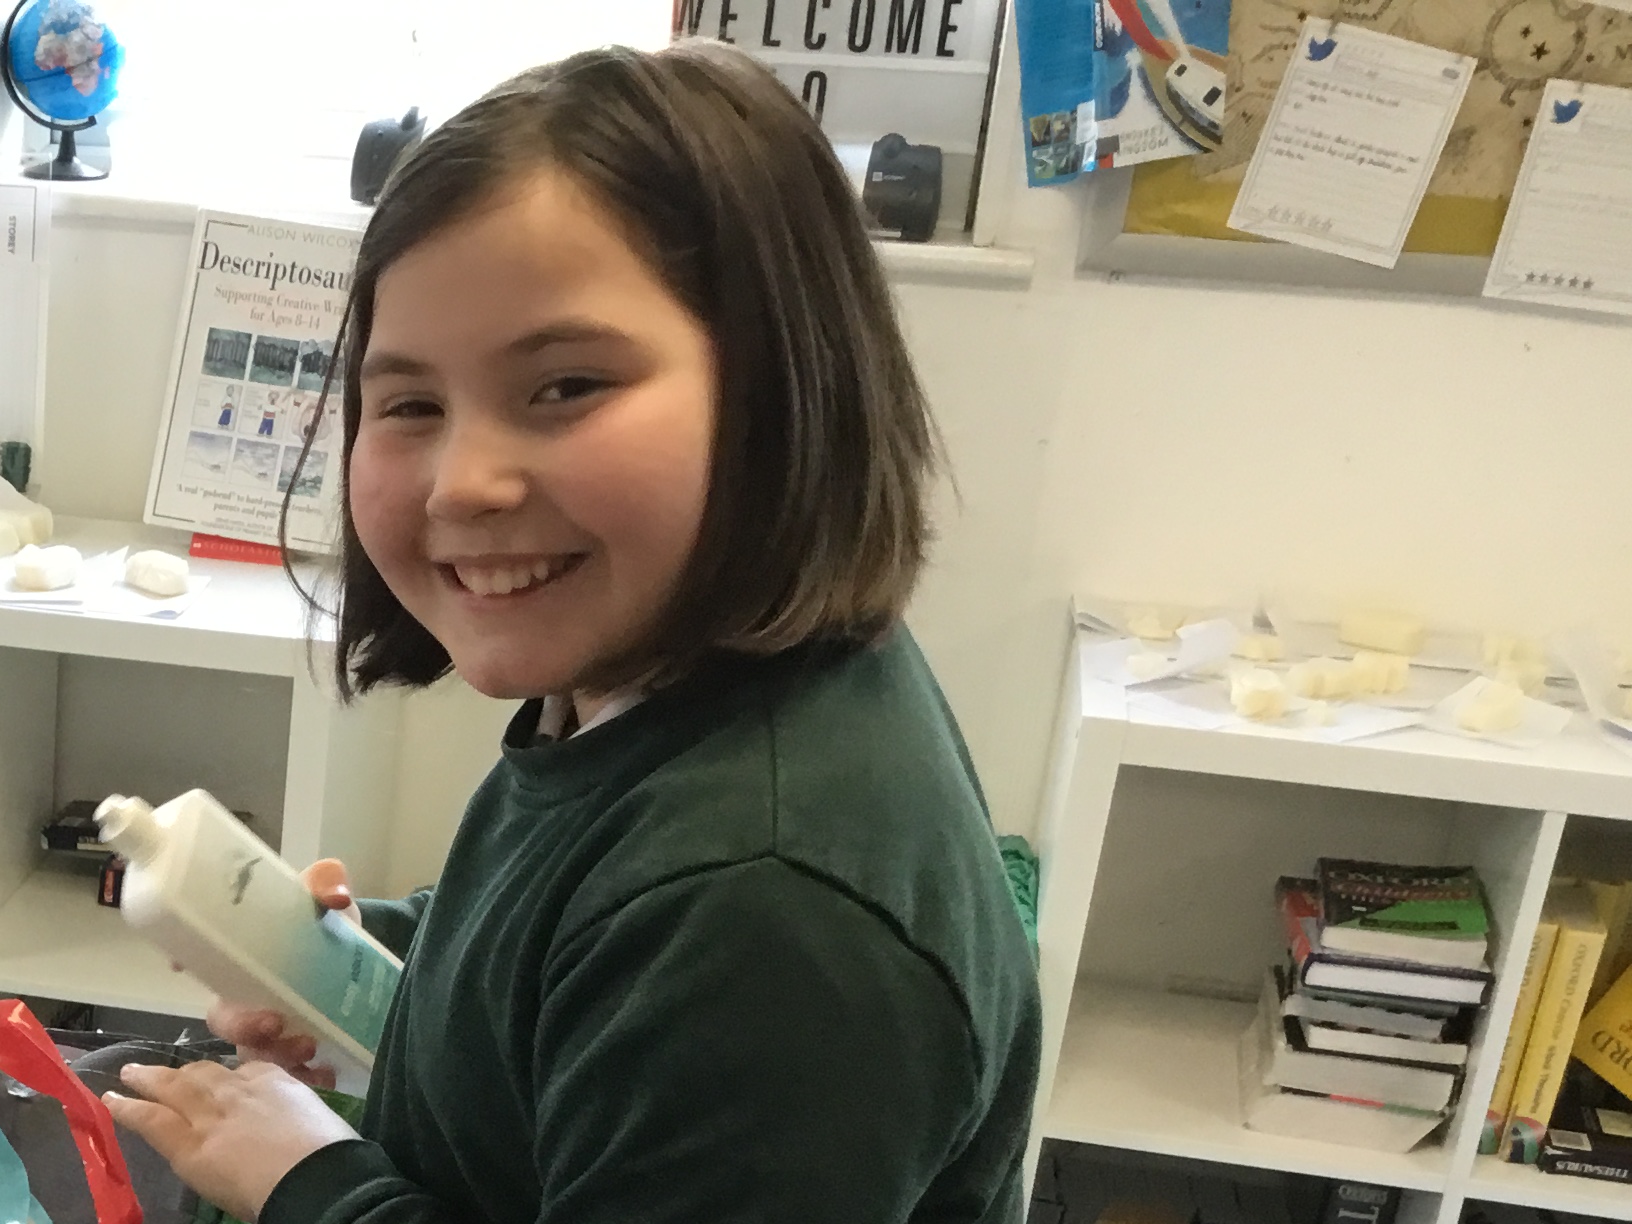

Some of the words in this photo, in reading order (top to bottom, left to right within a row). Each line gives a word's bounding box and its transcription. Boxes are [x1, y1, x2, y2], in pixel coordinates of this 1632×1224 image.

[246, 224, 297, 242] ALISON
[199, 240, 350, 291] Descriptosau
[214, 284, 274, 307] Supporting
[249, 307, 264, 322] for
[267, 311, 292, 329] Ages
